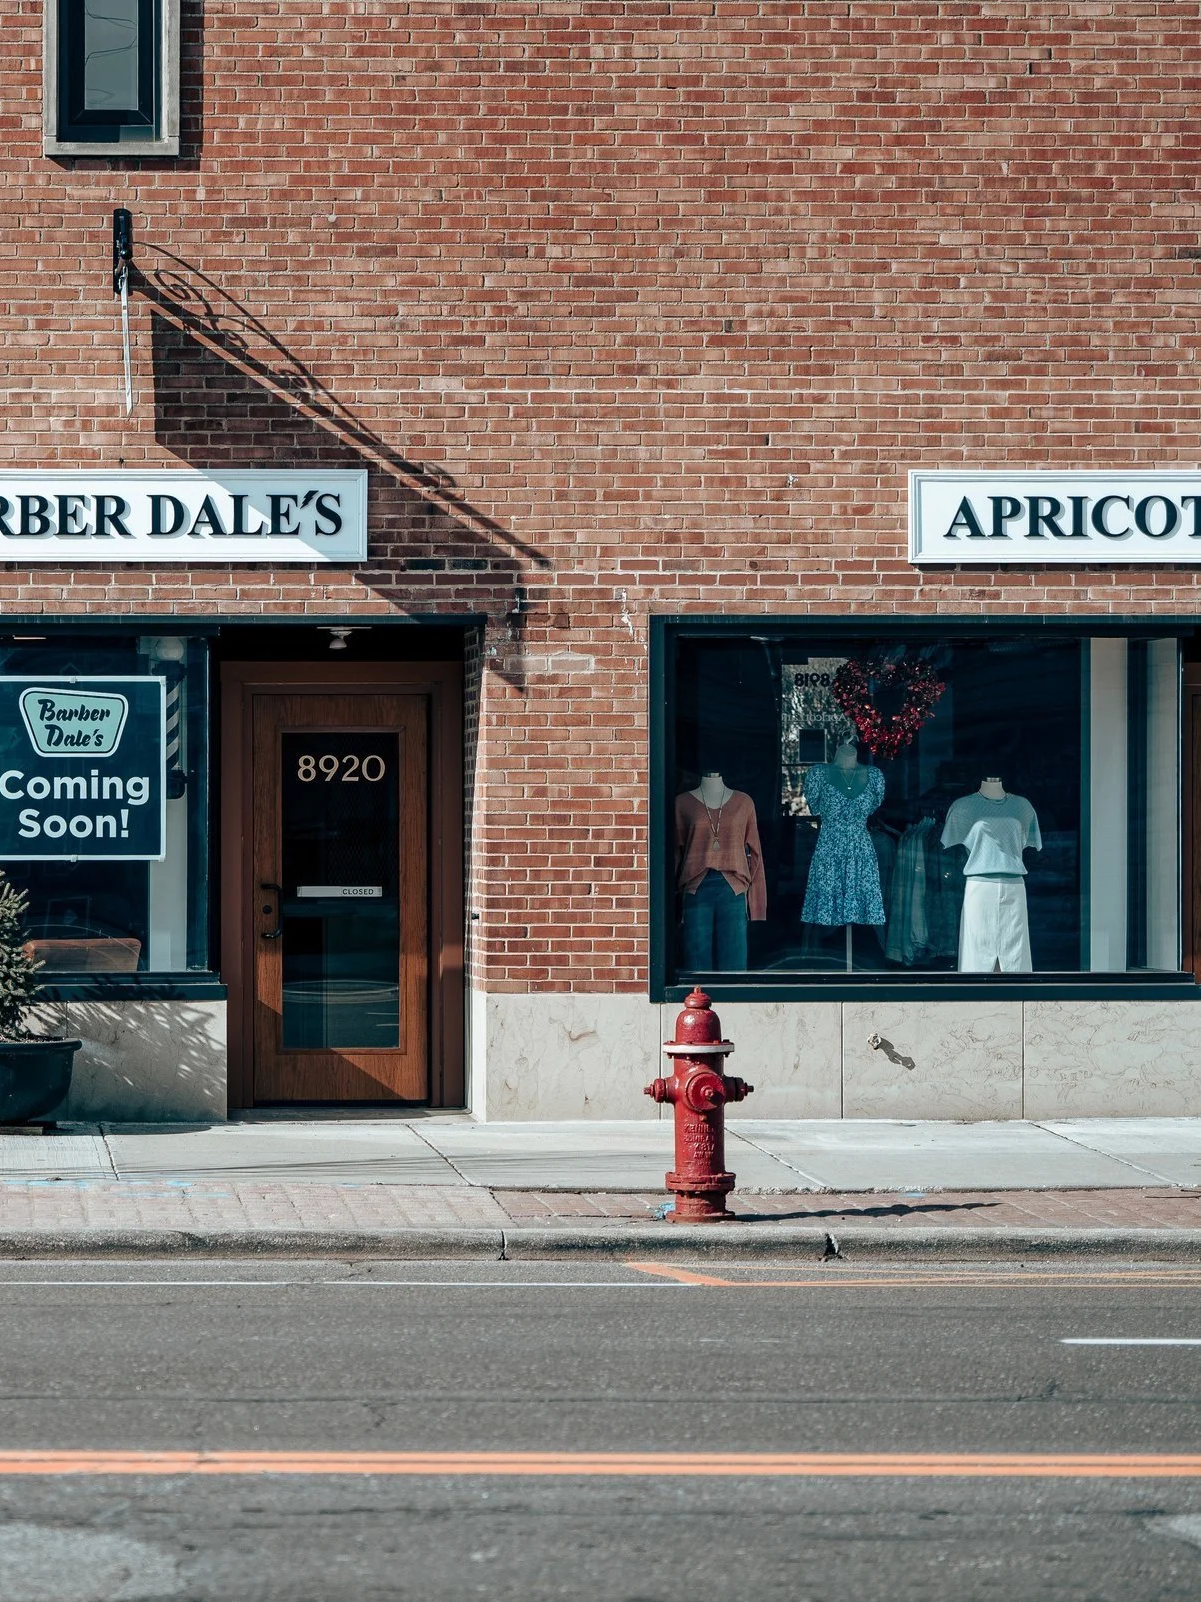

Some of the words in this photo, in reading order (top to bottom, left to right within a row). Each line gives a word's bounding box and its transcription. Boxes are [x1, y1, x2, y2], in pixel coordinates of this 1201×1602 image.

[146, 490, 343, 537] DALE'S
[942, 494, 1201, 538] APRICOT
[37, 698, 111, 722] Barber
[44, 723, 104, 747] Dale's
[297, 754, 386, 782] 8920
[18, 808, 130, 839] Soon!
